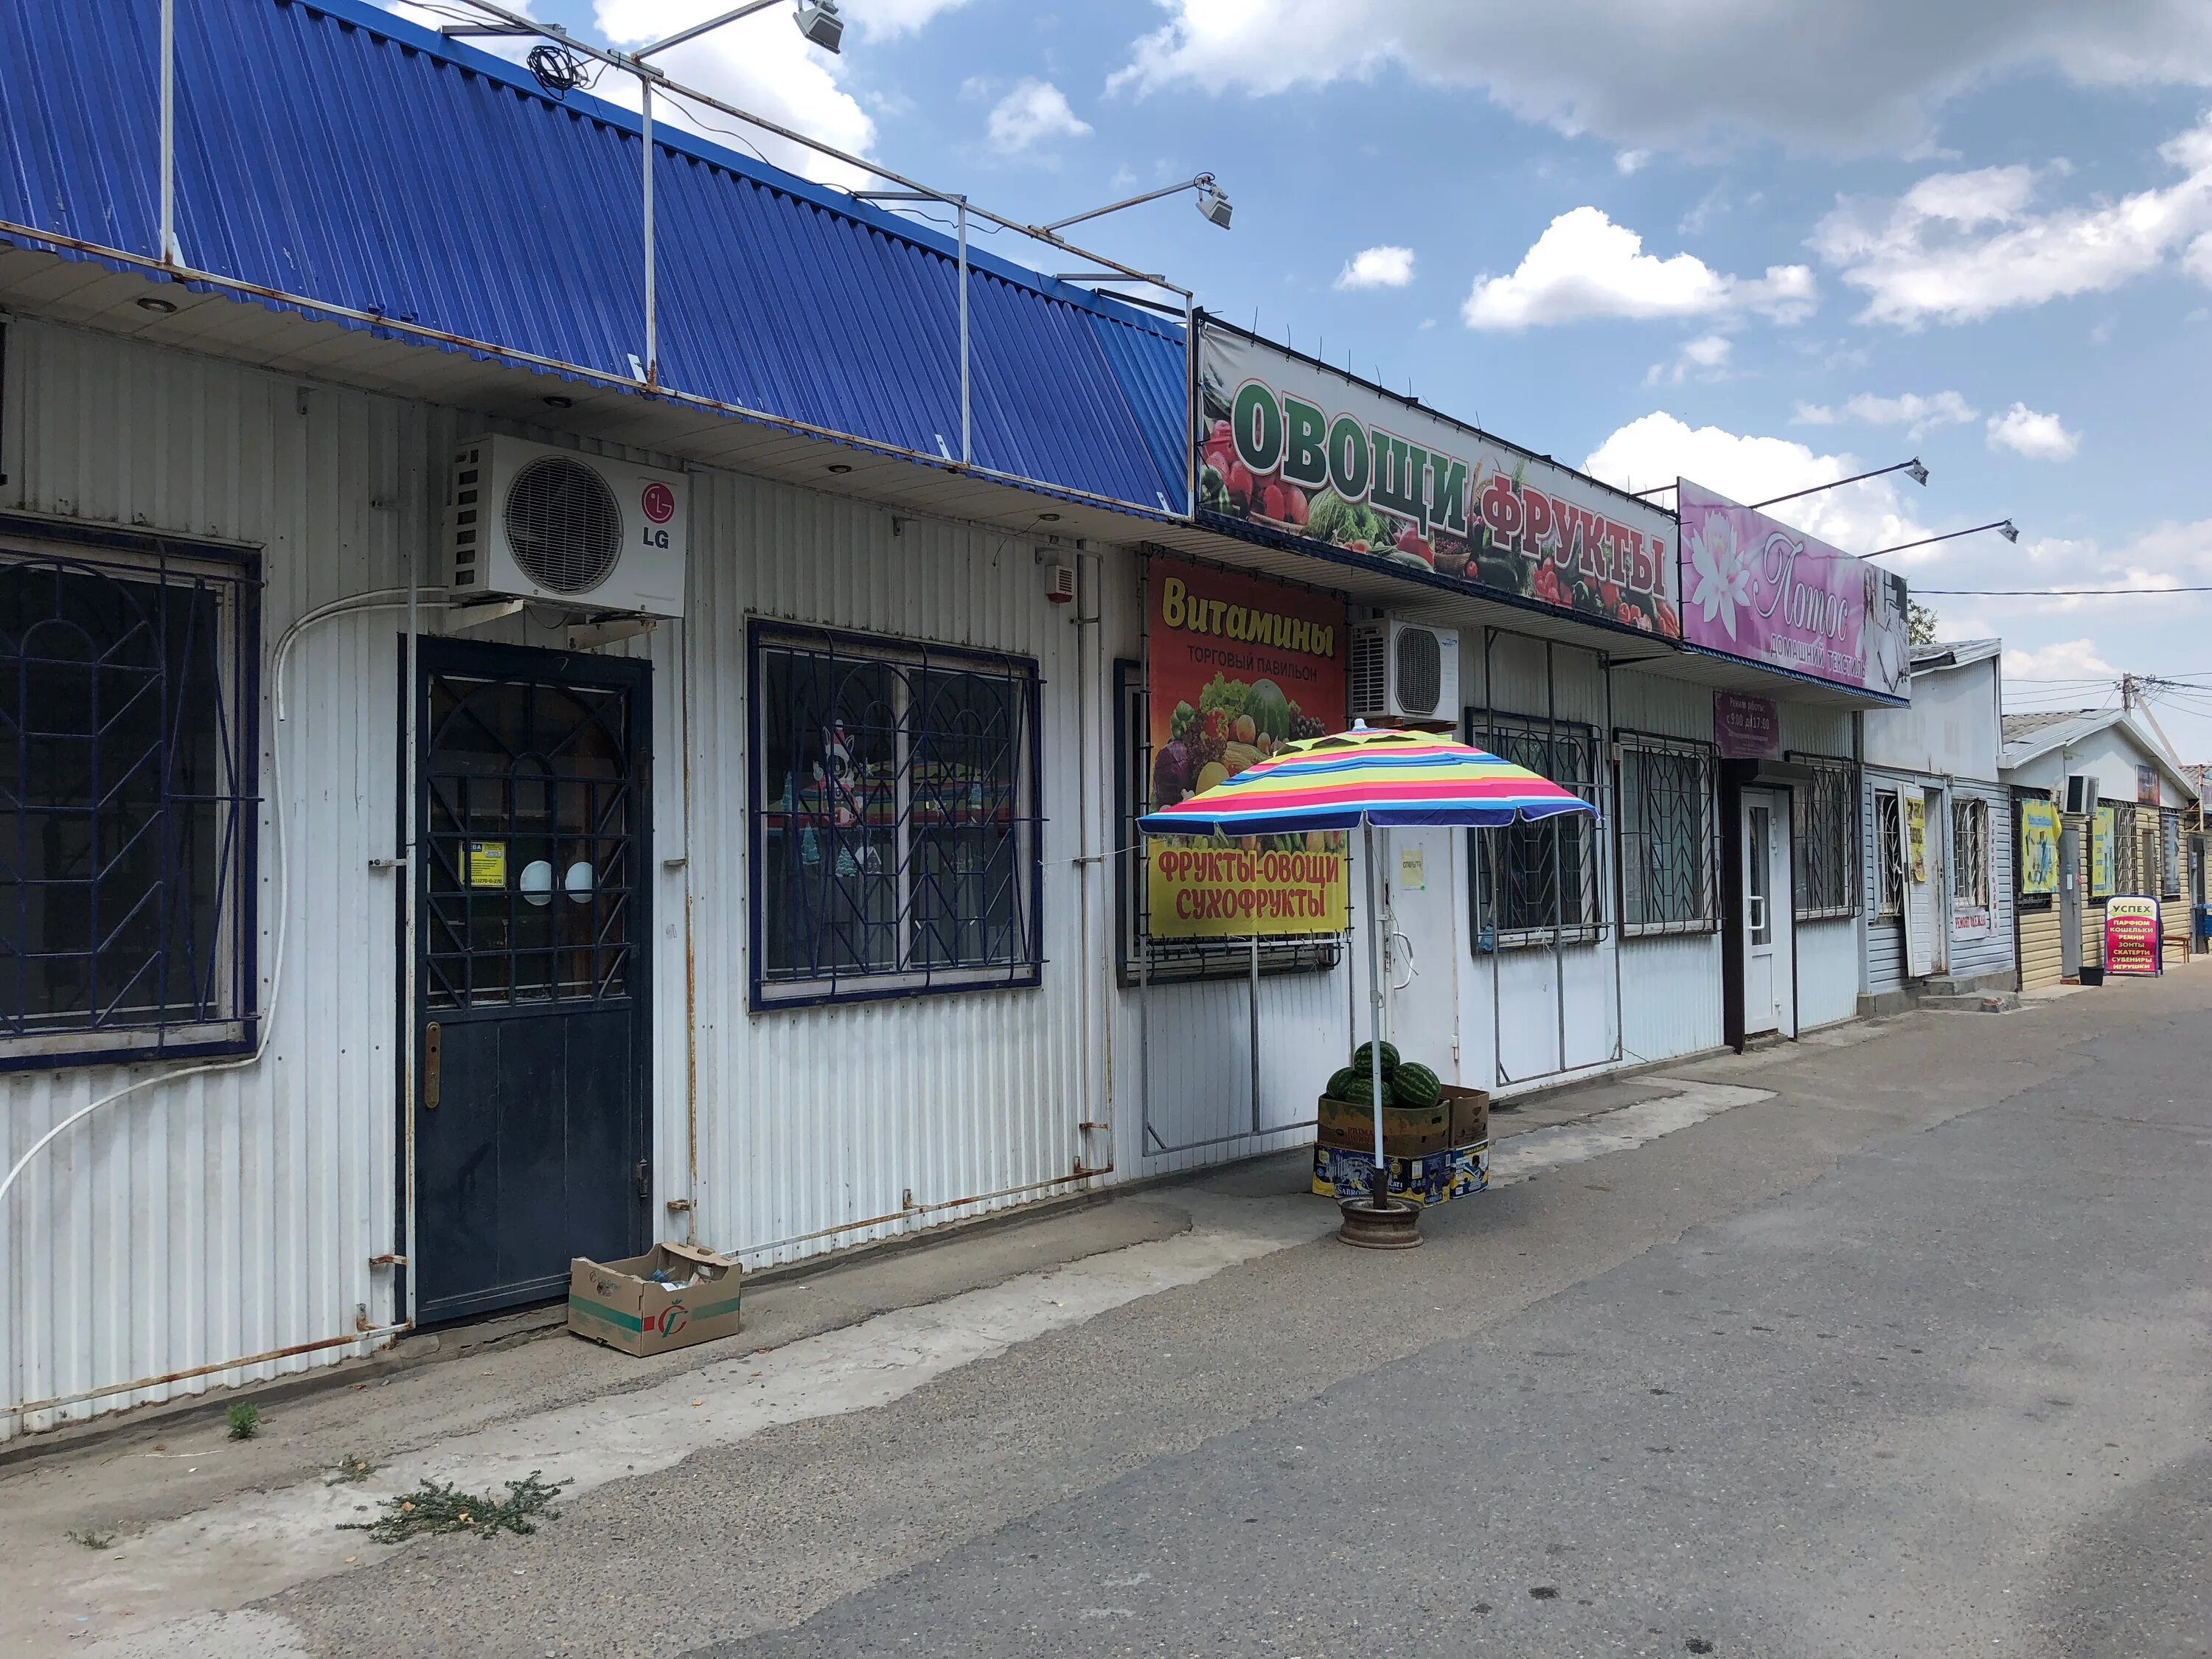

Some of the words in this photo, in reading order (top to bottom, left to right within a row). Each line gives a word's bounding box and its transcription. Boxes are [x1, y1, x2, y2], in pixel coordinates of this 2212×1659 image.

[1232, 378, 1469, 540] ОВОЩИ
[1481, 470, 1666, 599] ФРУКТЫ
[643, 527, 668, 549] LG
[1753, 532, 1848, 641] Лотос
[1162, 577, 1334, 658] Витамины
[1187, 644, 1253, 672] ТОРГОВЫЙ
[1257, 658, 1317, 681] ПАВИЛЬОН
[1770, 633, 1825, 669] ДОМАШНИЙ
[1828, 650, 1867, 679] ТЕКСТИЛЬ
[1158, 851, 1339, 888] ФРУКТЫ-ОВОЩИ
[1176, 888, 1325, 920] СУХОФРУКТЫ
